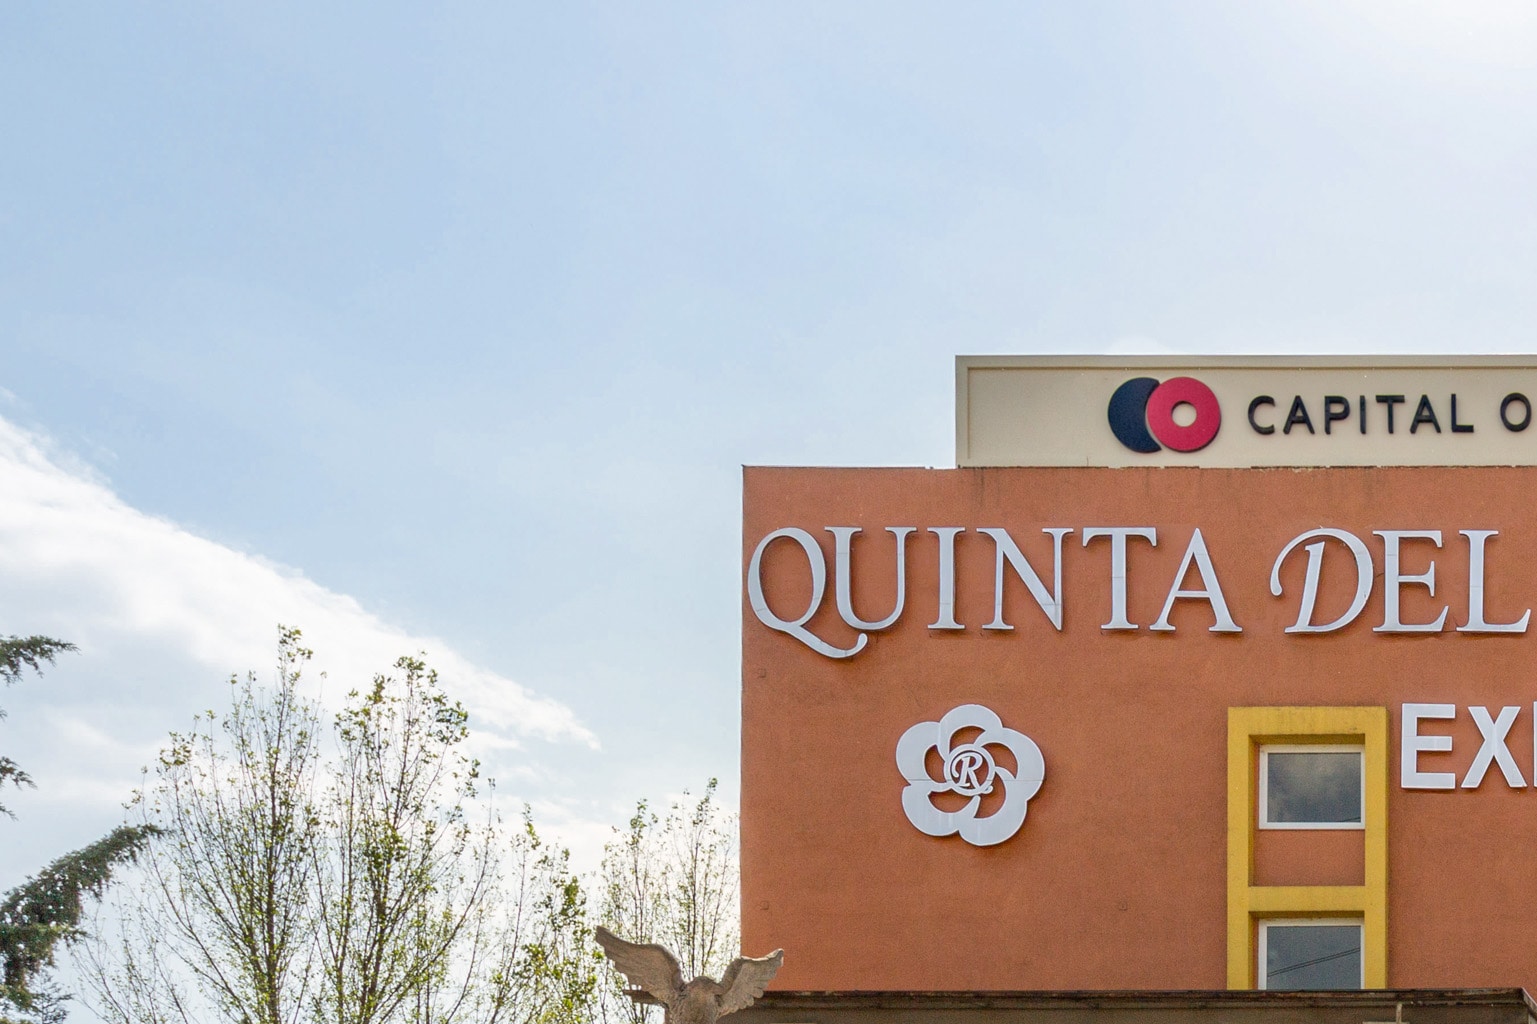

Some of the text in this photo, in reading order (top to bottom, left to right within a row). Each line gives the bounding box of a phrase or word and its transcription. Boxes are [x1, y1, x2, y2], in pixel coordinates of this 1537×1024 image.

[1247, 392, 1532, 435] CAPITAL O
[747, 526, 1244, 660] QUINTA
[1269, 527, 1532, 635] DEL
[951, 751, 994, 795] R
